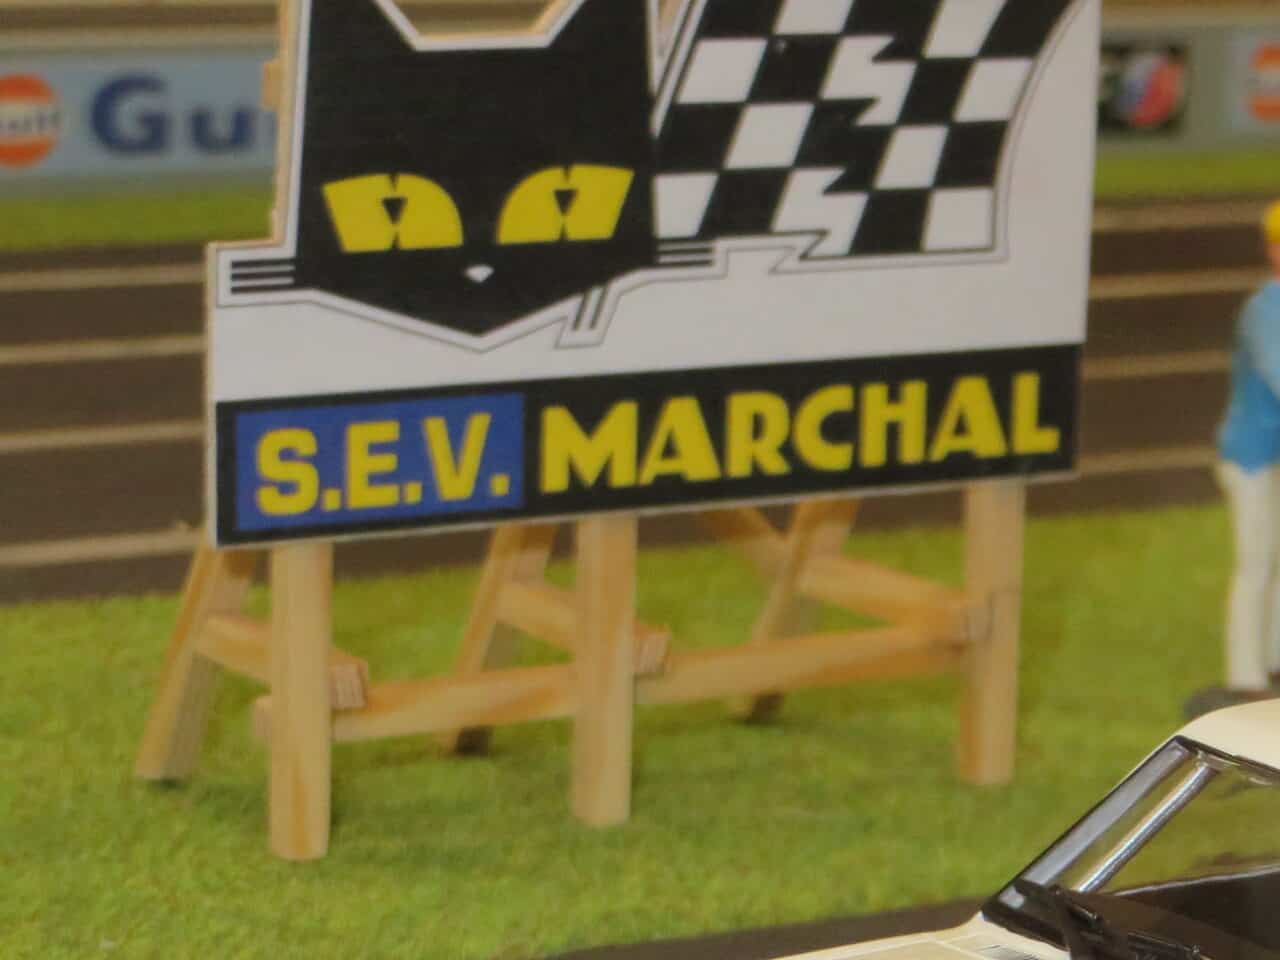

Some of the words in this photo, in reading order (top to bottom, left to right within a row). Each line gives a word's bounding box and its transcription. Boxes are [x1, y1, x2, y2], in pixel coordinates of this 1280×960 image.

[90, 72, 279, 155] Gu
[255, 412, 511, 517] S.E.V.
[539, 372, 1060, 493] MARCHAL
